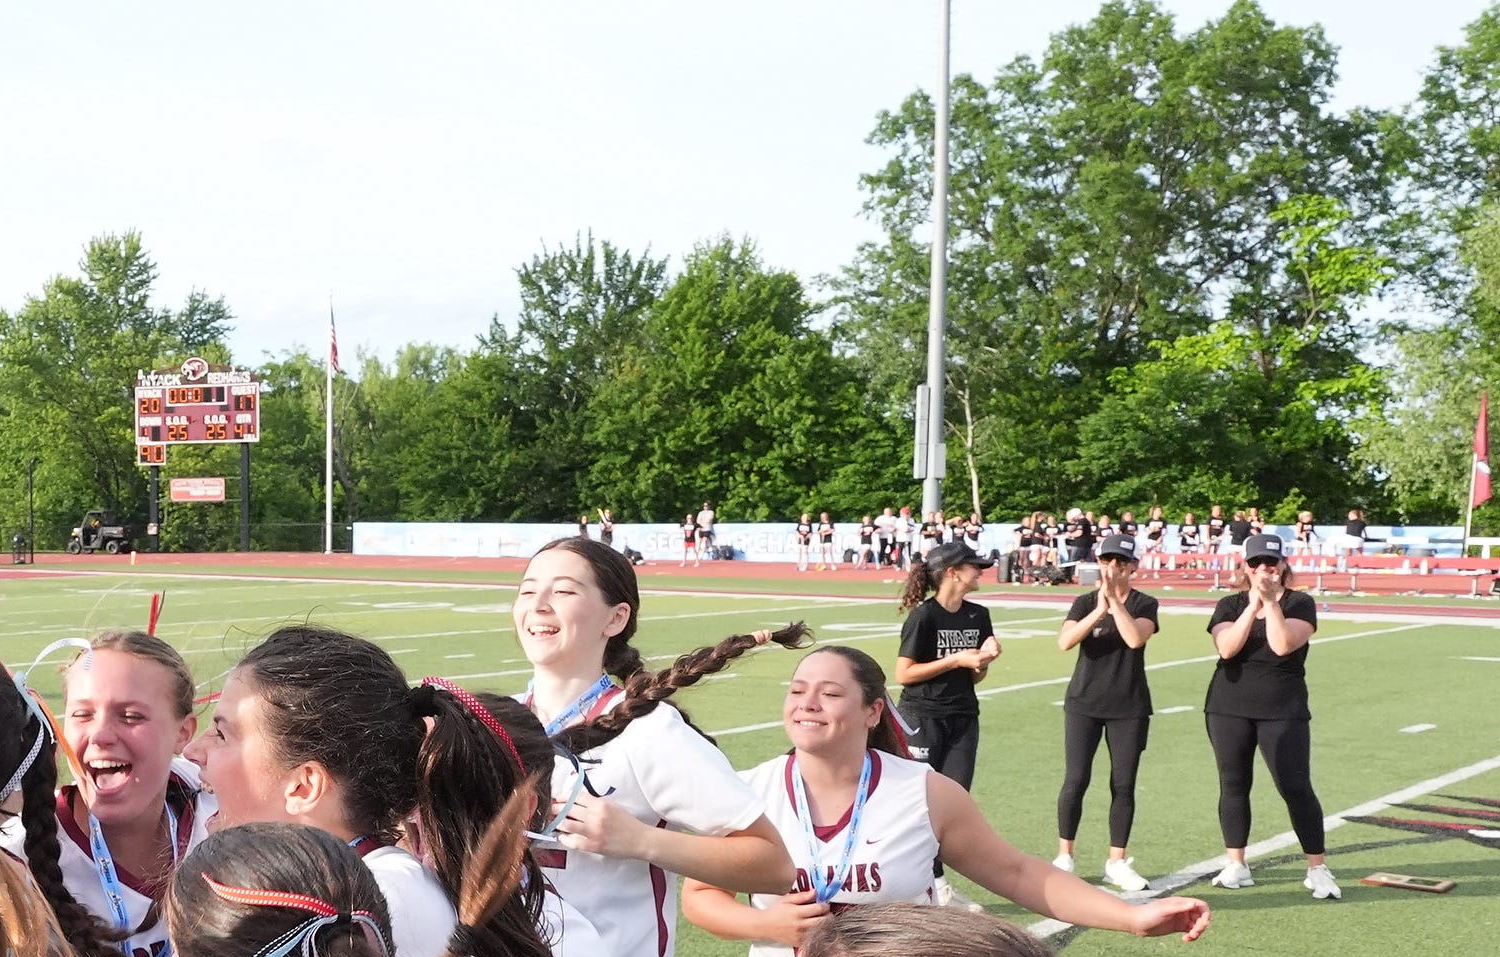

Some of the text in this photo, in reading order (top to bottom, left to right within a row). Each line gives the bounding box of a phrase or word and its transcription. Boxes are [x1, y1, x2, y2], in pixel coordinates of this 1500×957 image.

[141, 373, 181, 387] NYACK
[140, 394, 254, 414] 20 17
[168, 425, 188, 441] 25
[206, 424, 226, 440] 25
[234, 424, 243, 437] 4
[141, 445, 164, 462] 90
[937, 629, 980, 648] NYACK
